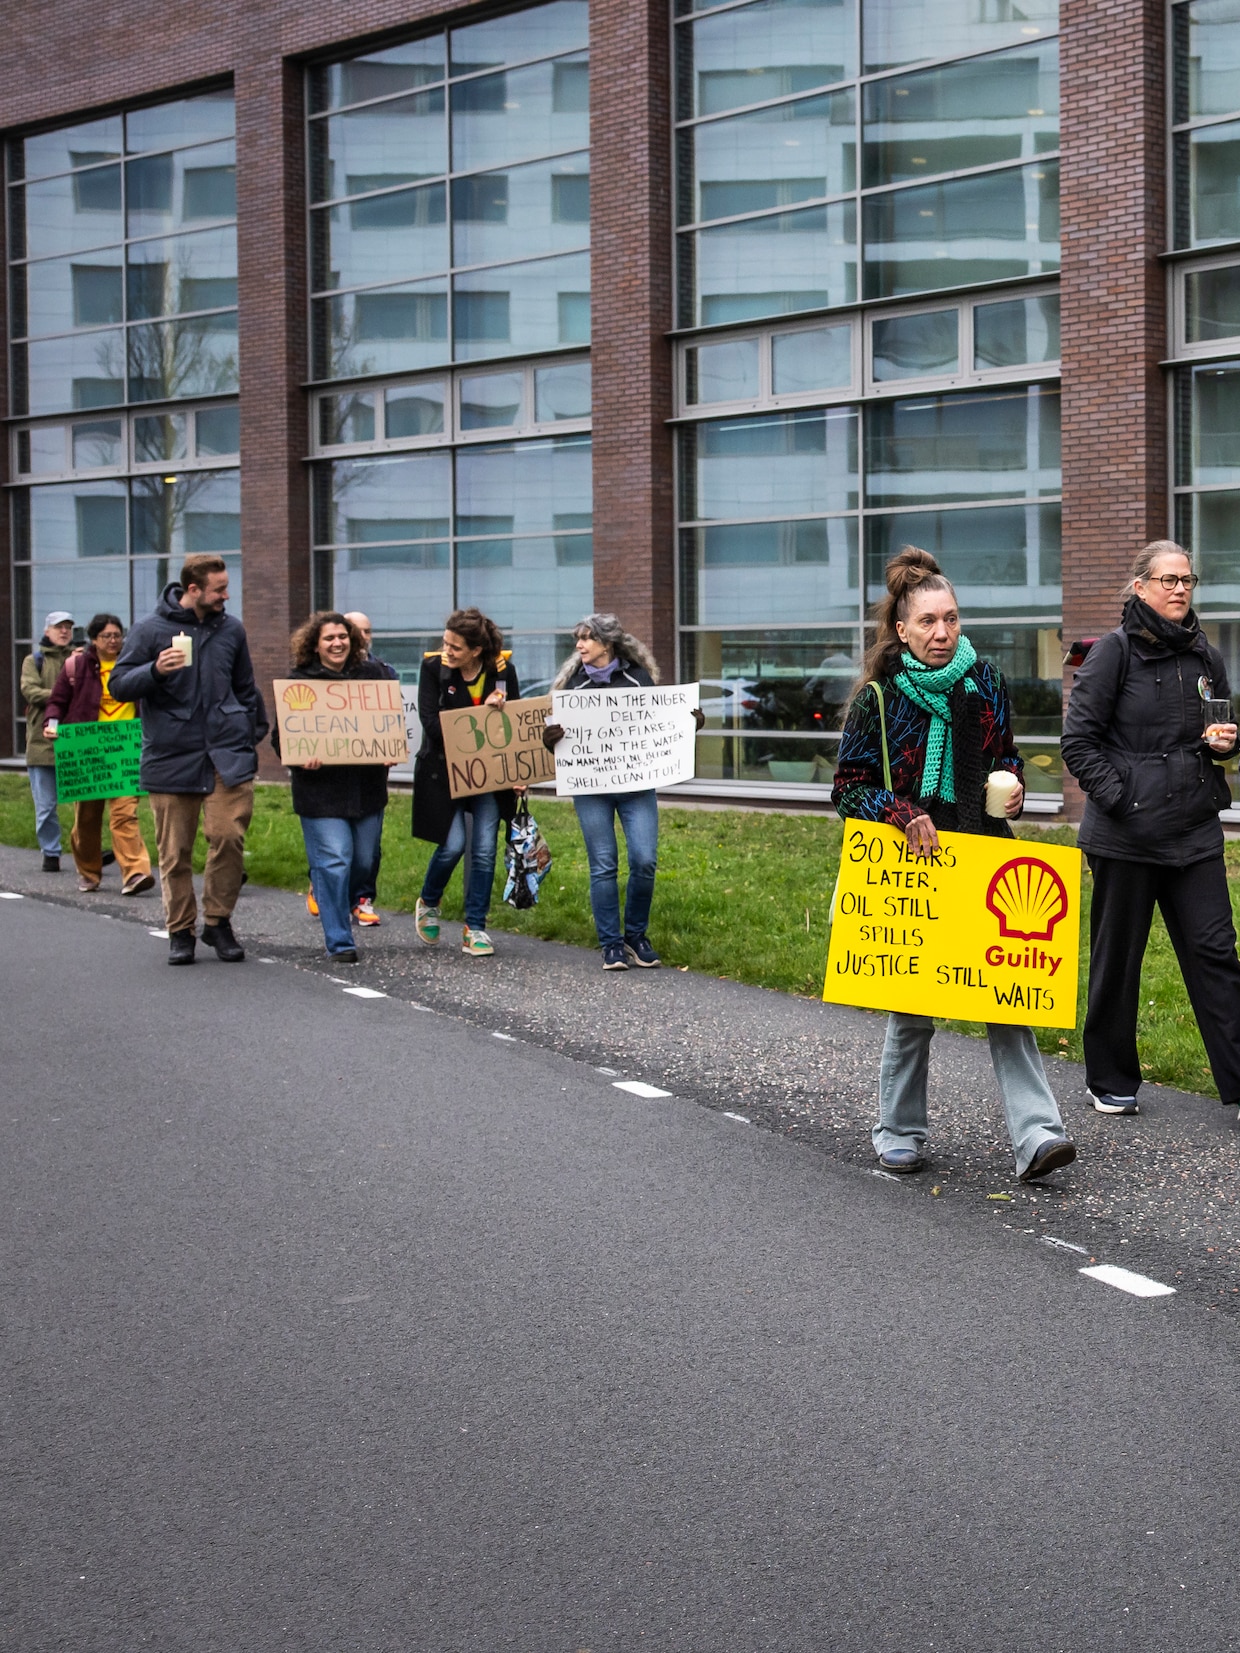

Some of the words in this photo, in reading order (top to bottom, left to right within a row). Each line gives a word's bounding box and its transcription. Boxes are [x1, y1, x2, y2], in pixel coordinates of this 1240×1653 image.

[326, 683, 401, 712] SHELL
[556, 693, 601, 710] TODAY
[606, 696, 618, 707] IN
[622, 694, 647, 708] THE
[651, 692, 687, 707] NIGER
[284, 715, 359, 734] CLEAN
[372, 714, 402, 734] UP!
[453, 709, 513, 754] 30
[564, 725, 593, 745] 24/7
[597, 726, 623, 740] GAS
[286, 737, 320, 757] PAY
[325, 738, 350, 758] UP!
[351, 738, 387, 758] OWN
[571, 744, 593, 756] OIL
[600, 743, 613, 753] IN
[620, 740, 648, 752] THE
[653, 731, 685, 748] WATER
[451, 757, 487, 793] NO
[556, 758, 574, 768] HOW
[576, 756, 600, 768] MANY
[603, 755, 626, 765] MUST
[566, 776, 608, 791] SHELL,
[611, 772, 644, 785] CLEAN
[662, 758, 681, 777] UP!
[849, 830, 884, 864] 30
[893, 840, 957, 867] YEARS
[841, 891, 873, 917] OIL
[884, 896, 939, 921] STILL
[860, 925, 924, 947] SPILLS
[985, 945, 1063, 977] Guilty
[836, 949, 920, 977] JUSTICE
[936, 964, 988, 988] STILL
[993, 982, 1055, 1011] WAITS
